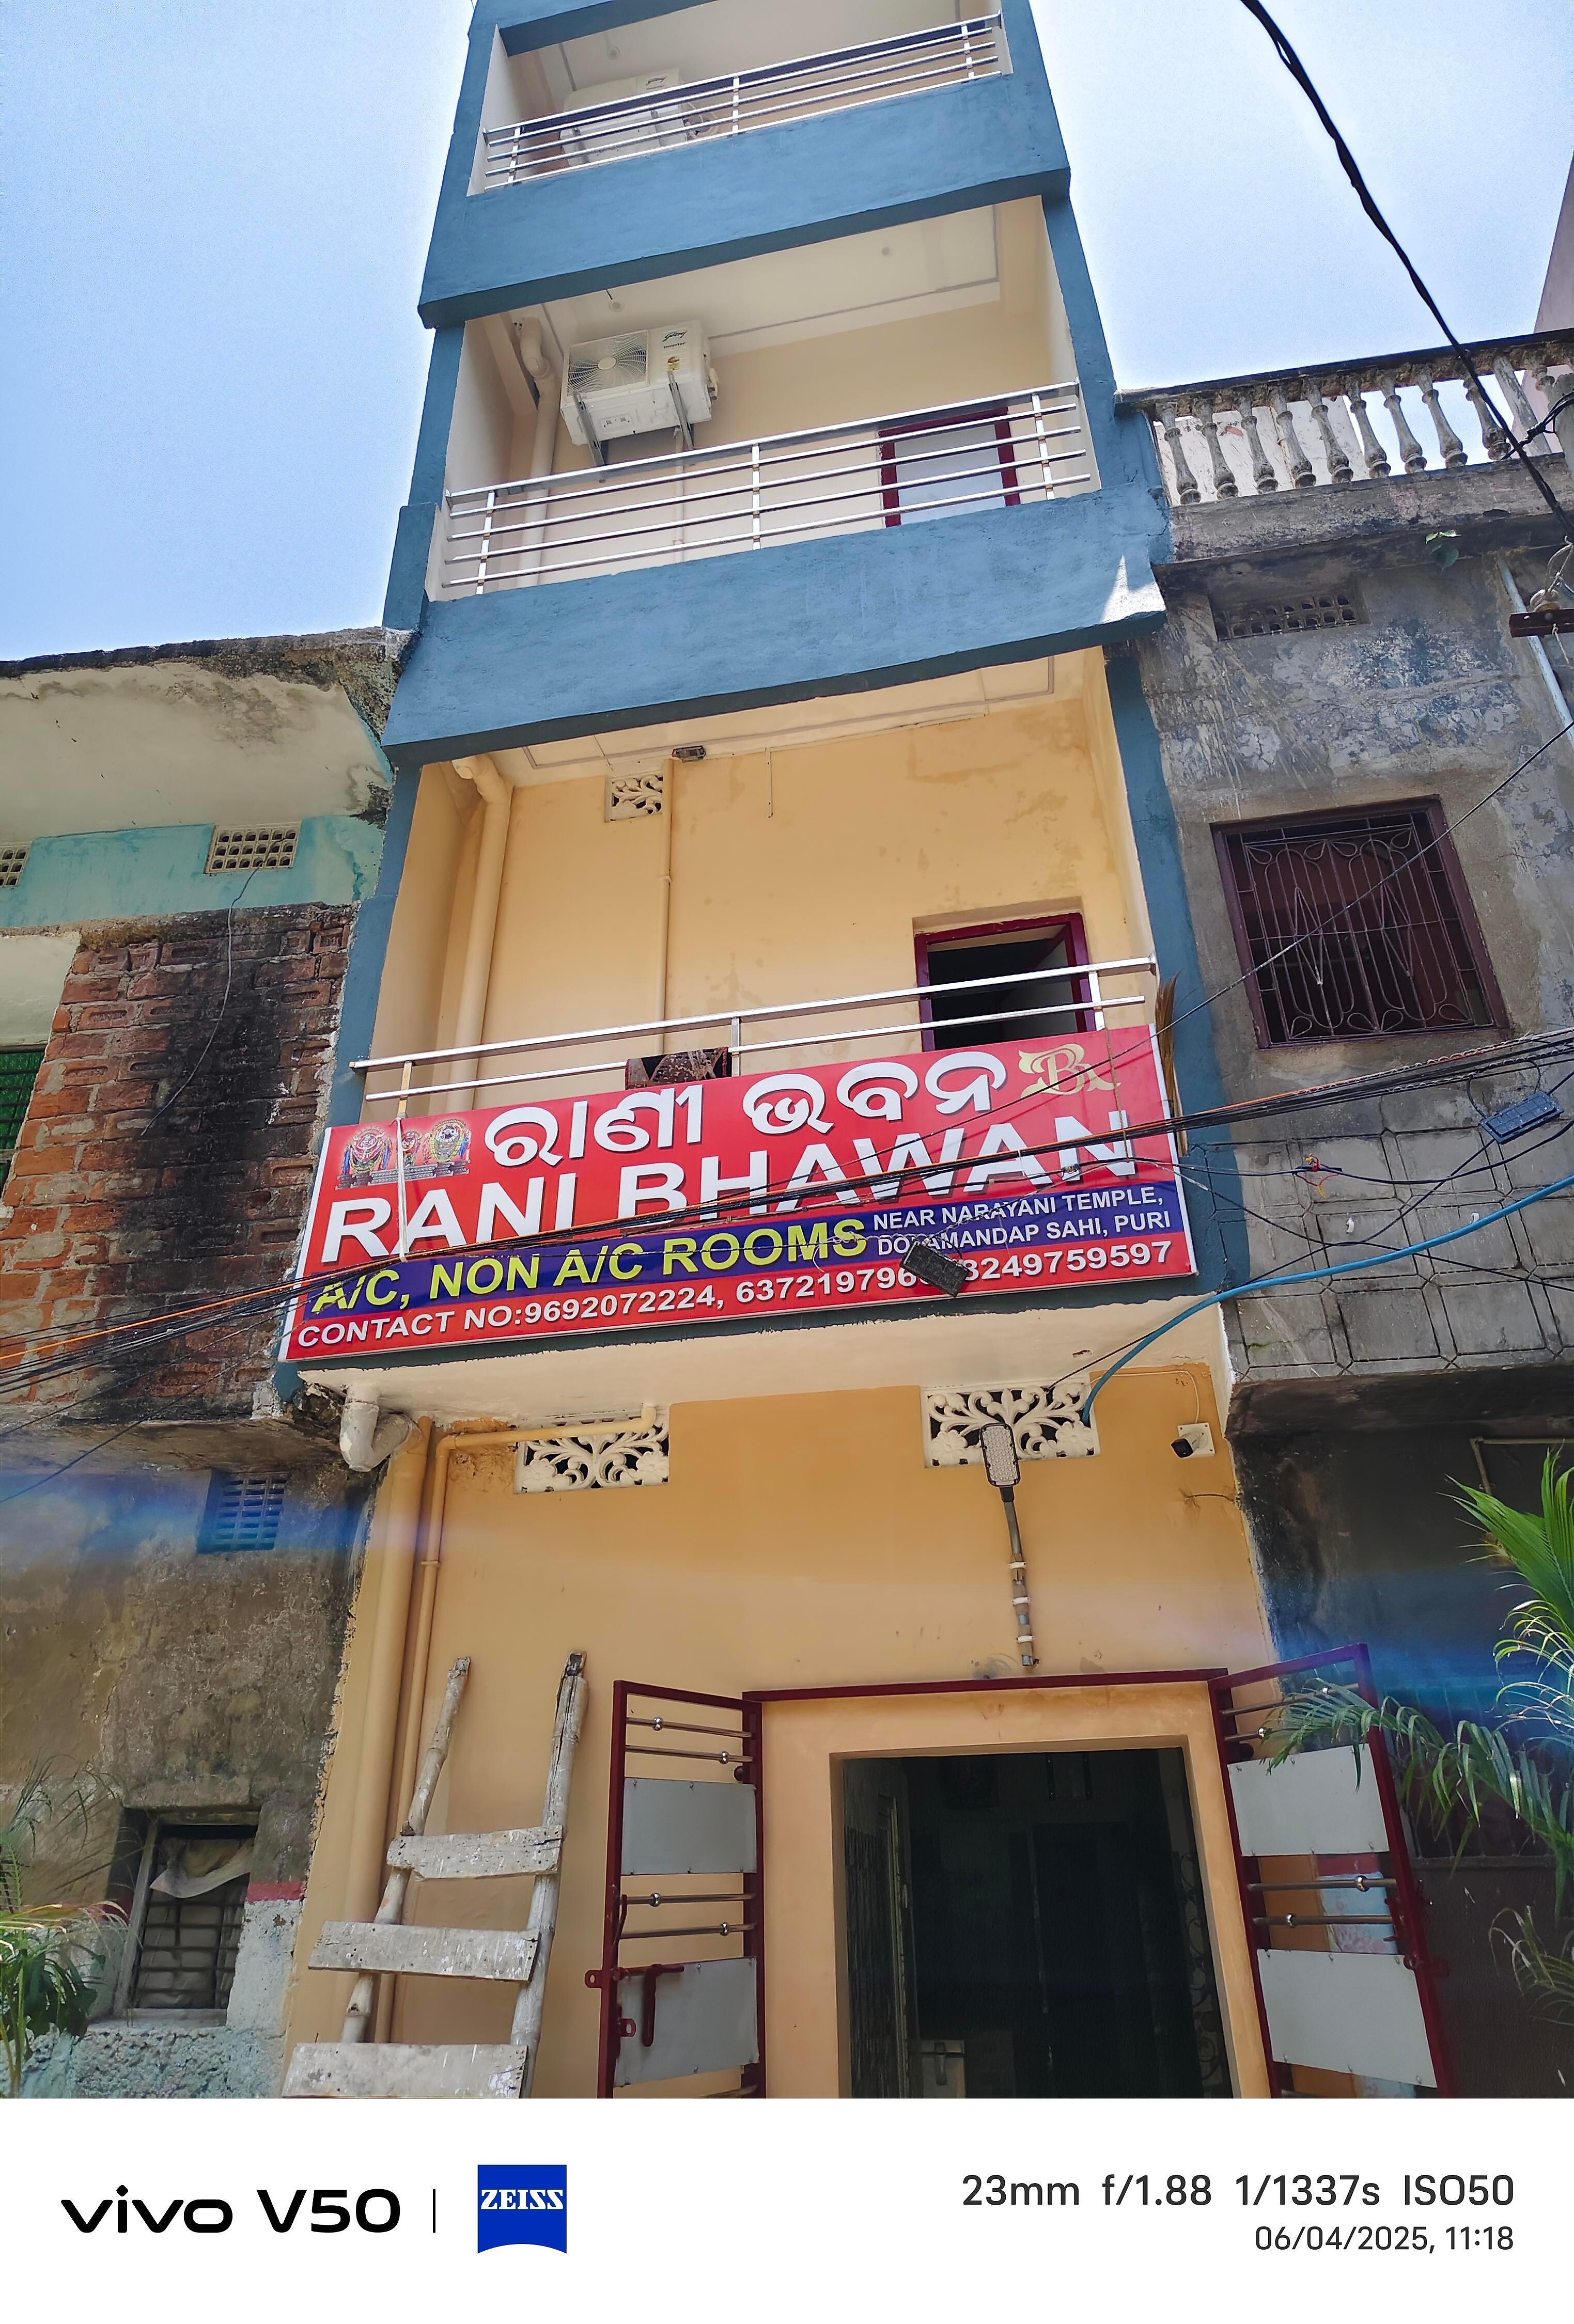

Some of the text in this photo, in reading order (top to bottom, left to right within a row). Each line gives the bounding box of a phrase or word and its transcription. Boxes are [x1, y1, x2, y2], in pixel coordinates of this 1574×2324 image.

[484, 1051, 1007, 1167] ରାଣୀ ଭବନ
[321, 1110, 1135, 1264] RANI BHAWAN
[873, 1186, 1163, 1231] NEAR NARAYANI TEMPLE,
[310, 1219, 866, 1313] A/C, NON A/C ROOMS
[878, 1211, 1171, 1256] DOAMANDAP SAHI, PURI
[298, 1311, 455, 1347] CONTACT
[463, 1285, 724, 1331] NO:9692072224,
[736, 1261, 930, 1303] 637219796
